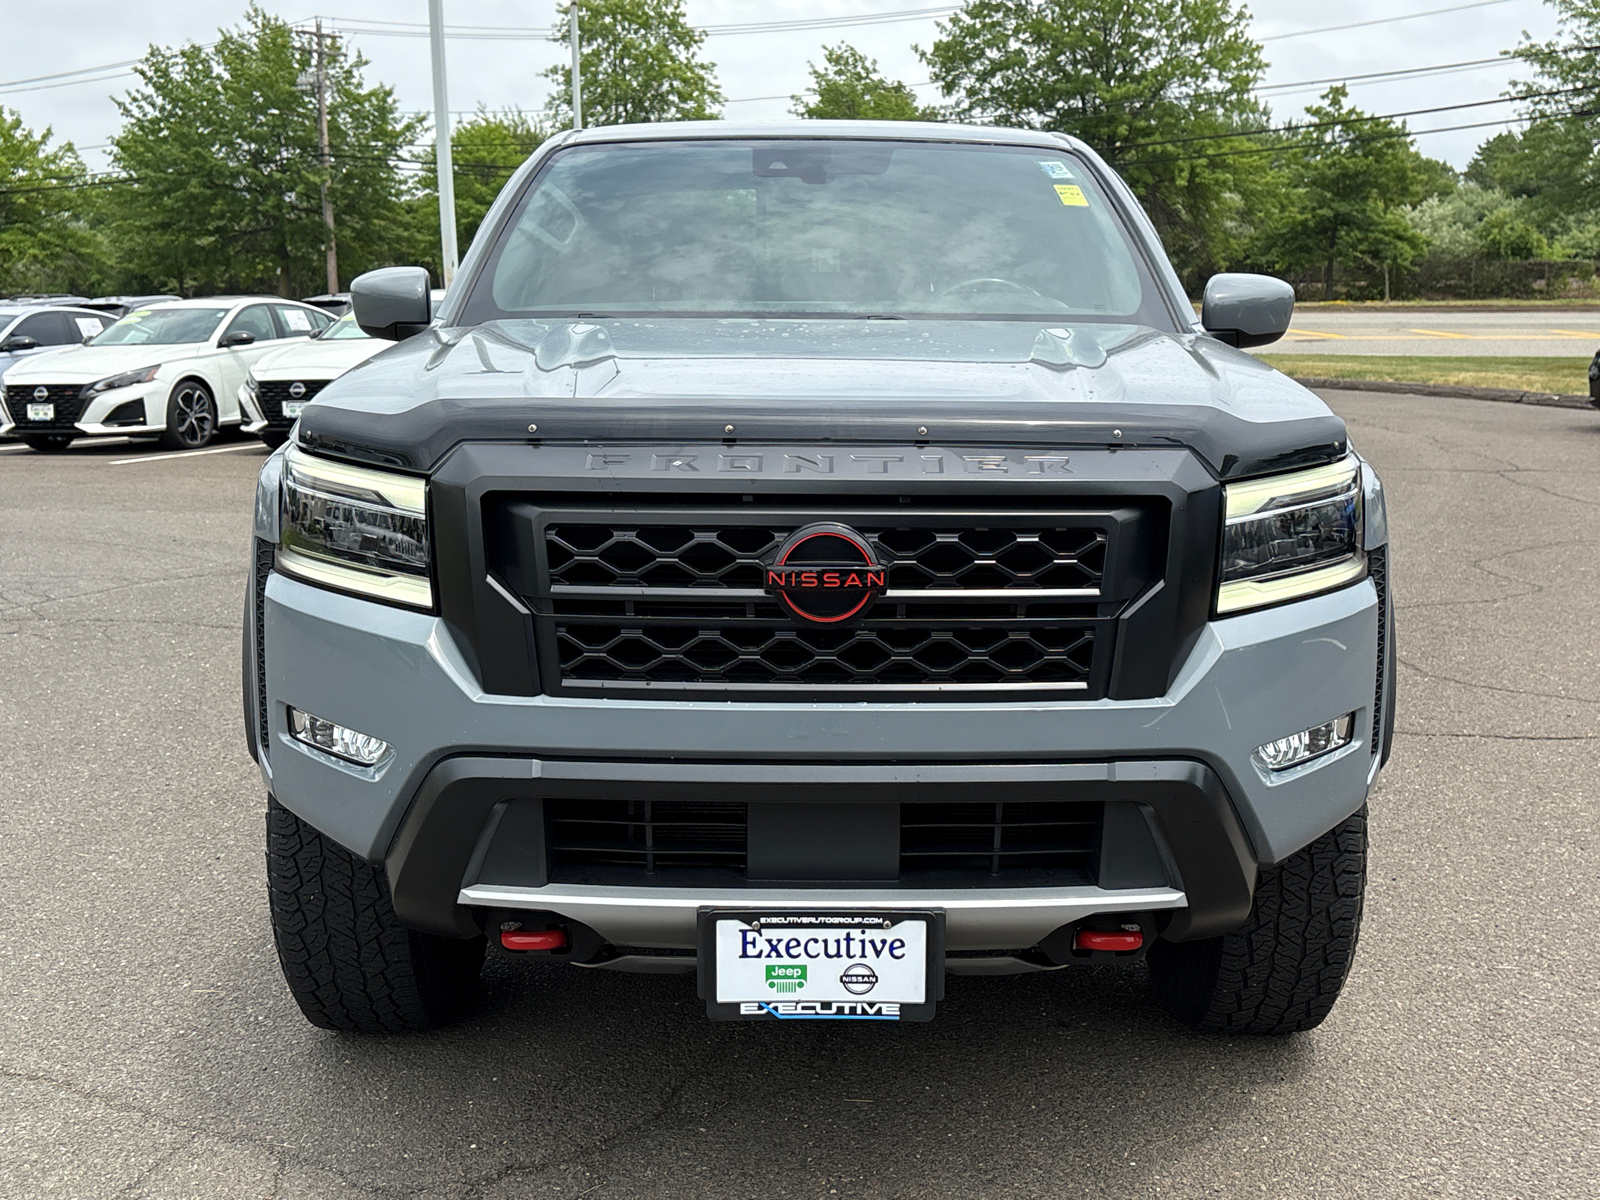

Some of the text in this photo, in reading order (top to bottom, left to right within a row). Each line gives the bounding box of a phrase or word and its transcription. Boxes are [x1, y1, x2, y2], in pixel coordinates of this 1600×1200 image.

[585, 453, 1076, 475] FRONTIER
[768, 571, 885, 588] NISSAN
[760, 916, 883, 924] EXECUTIVEAUTOGROUP.COM
[738, 928, 906, 960] Executive
[771, 966, 802, 978] Jeep
[739, 1002, 901, 1015] EXECUTIVE
